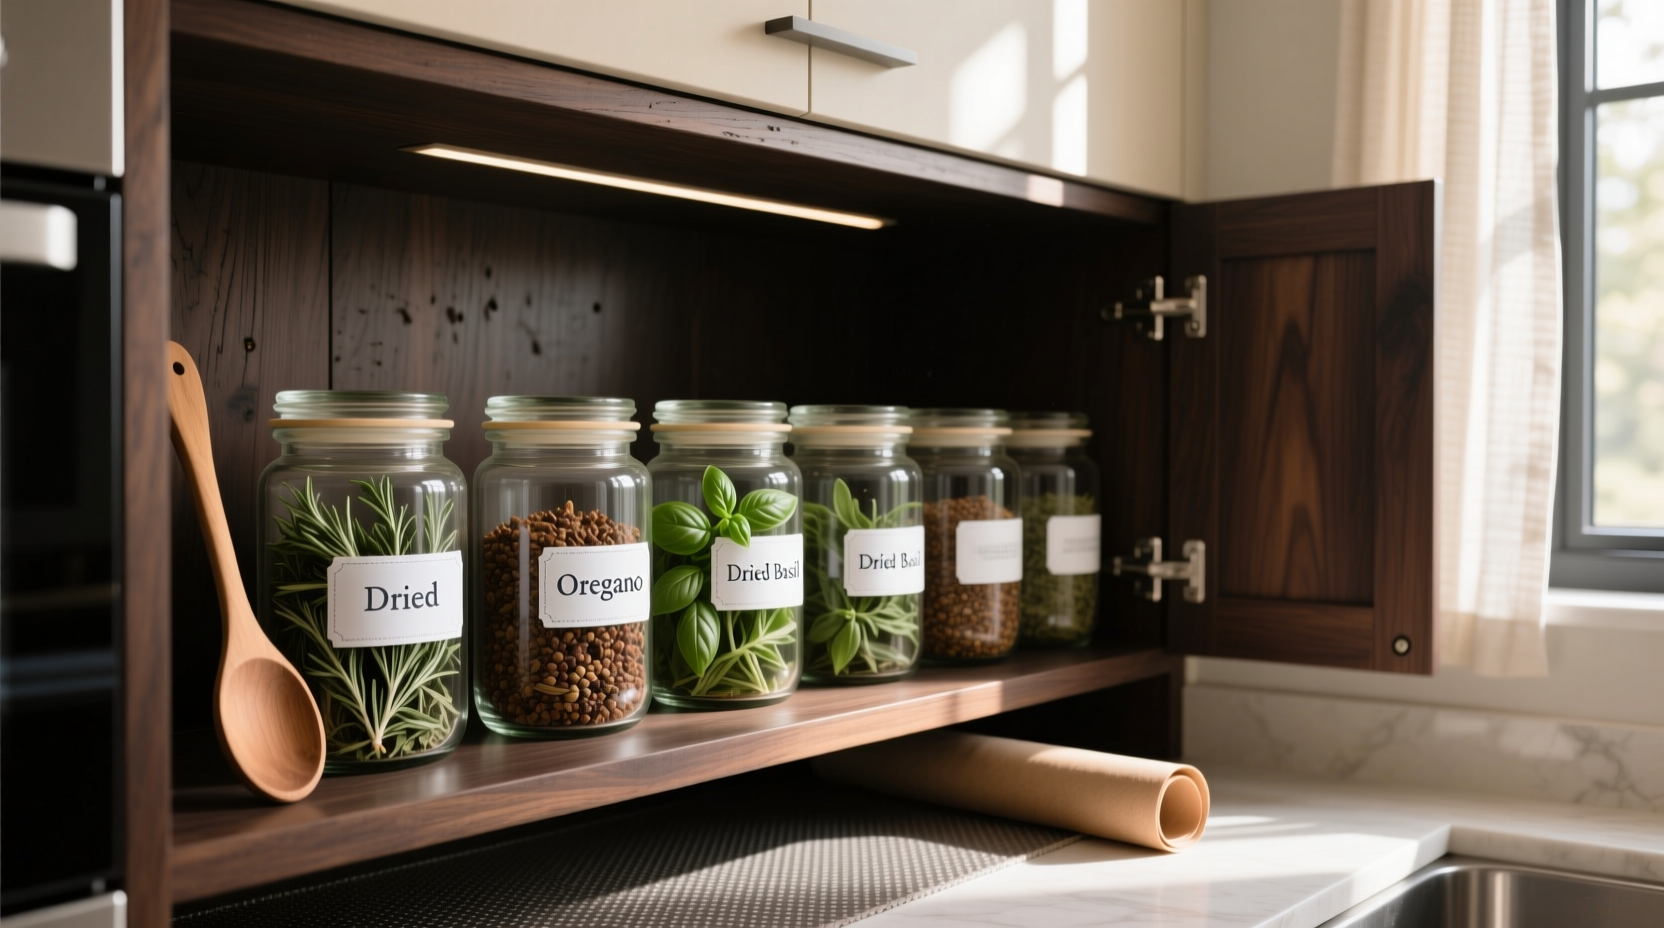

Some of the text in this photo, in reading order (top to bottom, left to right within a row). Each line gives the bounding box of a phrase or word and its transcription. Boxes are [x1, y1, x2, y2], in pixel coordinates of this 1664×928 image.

[727, 562, 770, 582] Dried
[859, 552, 896, 570] Dried
[364, 581, 439, 612] Dried
[556, 573, 643, 601] Oregano
